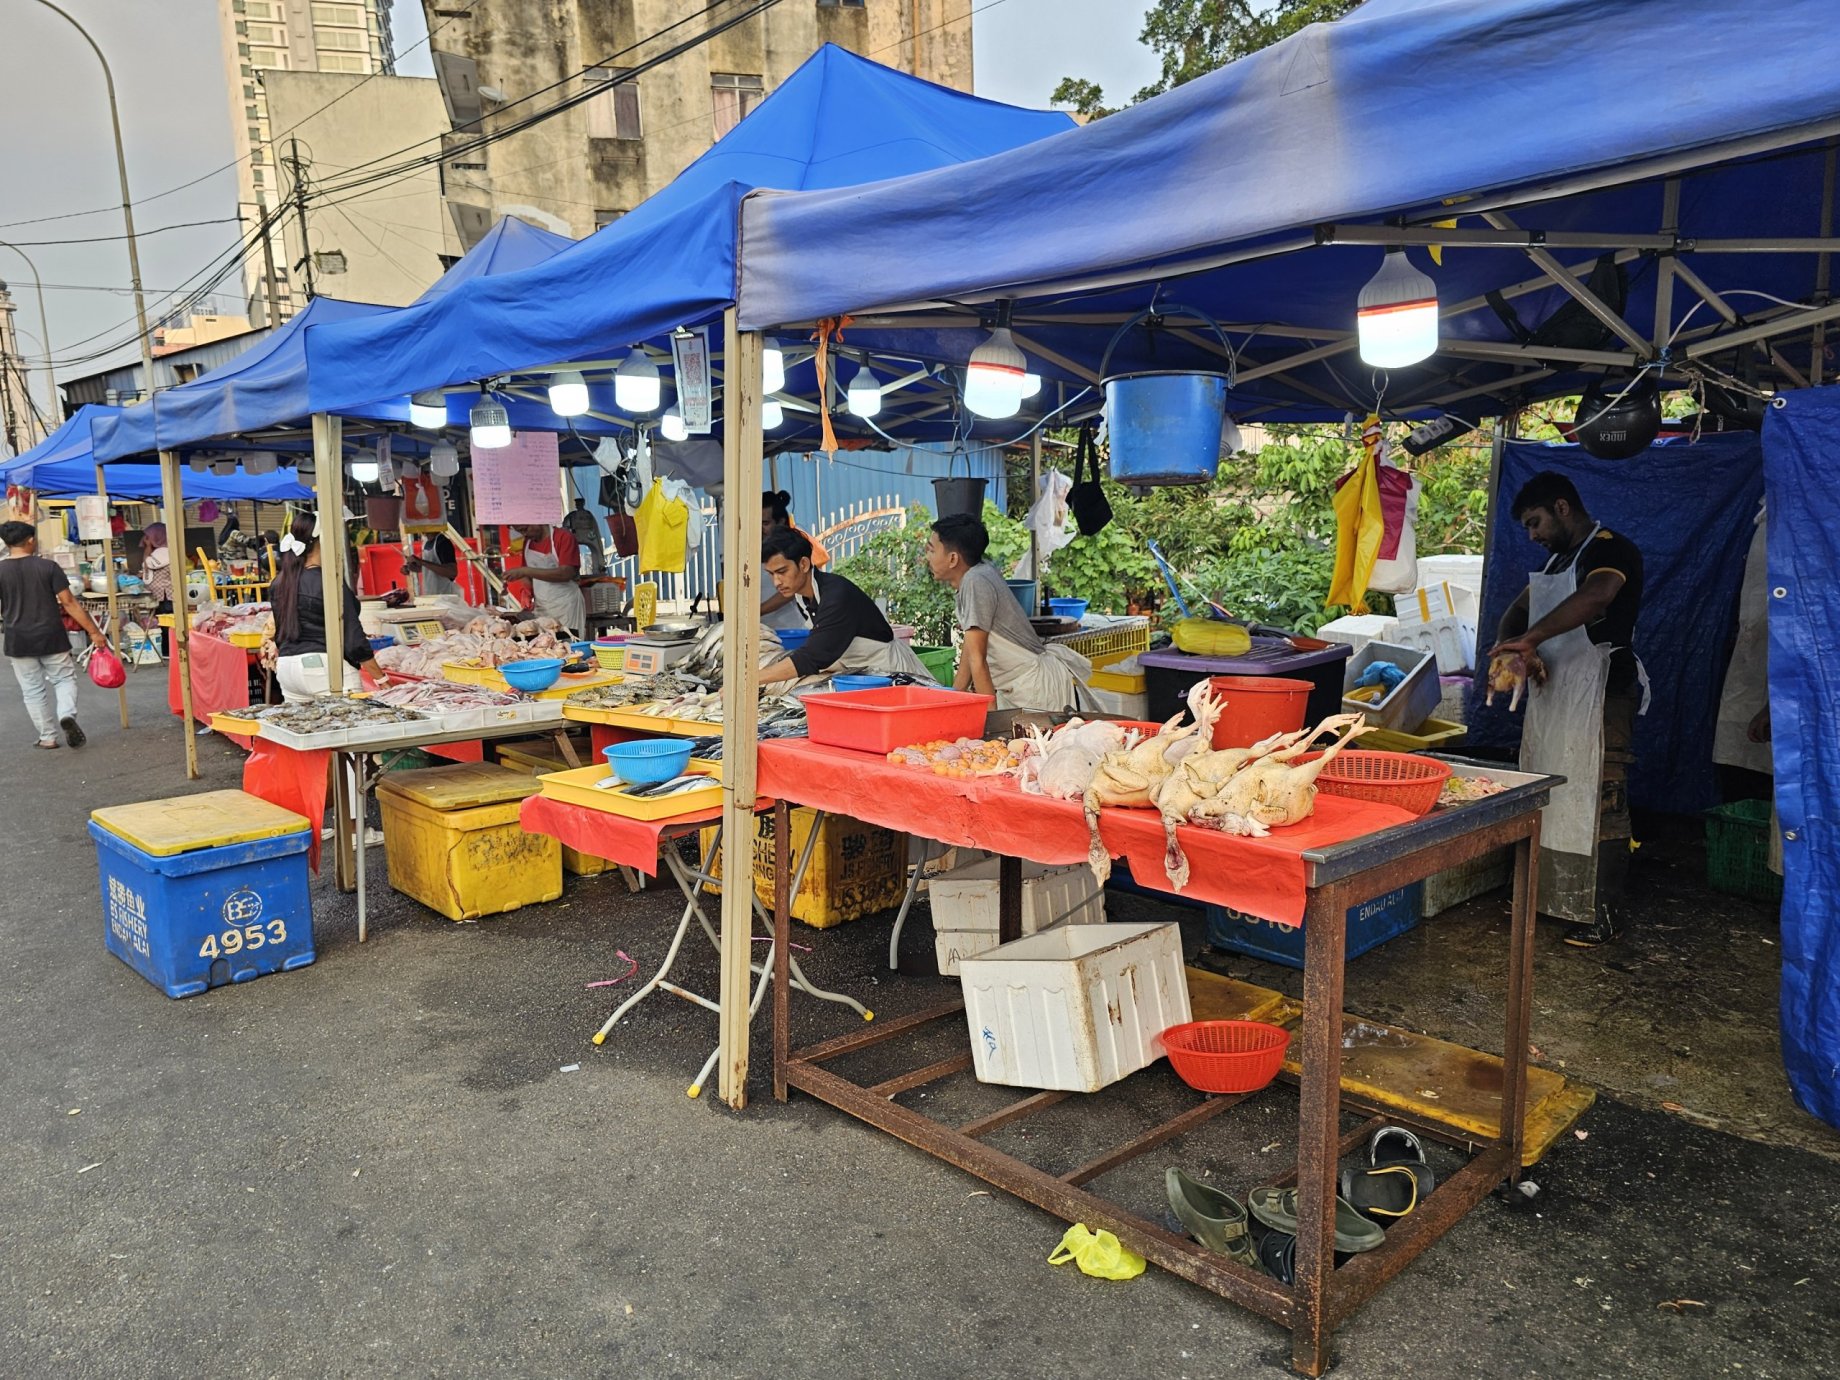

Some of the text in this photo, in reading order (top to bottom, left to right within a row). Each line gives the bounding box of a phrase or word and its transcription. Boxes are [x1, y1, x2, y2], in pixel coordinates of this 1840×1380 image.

[1599, 430, 1627, 442] INDEX
[119, 906, 148, 940] FISHERY
[1359, 897, 1386, 921] ENDAU
[198, 919, 288, 959] 4953
